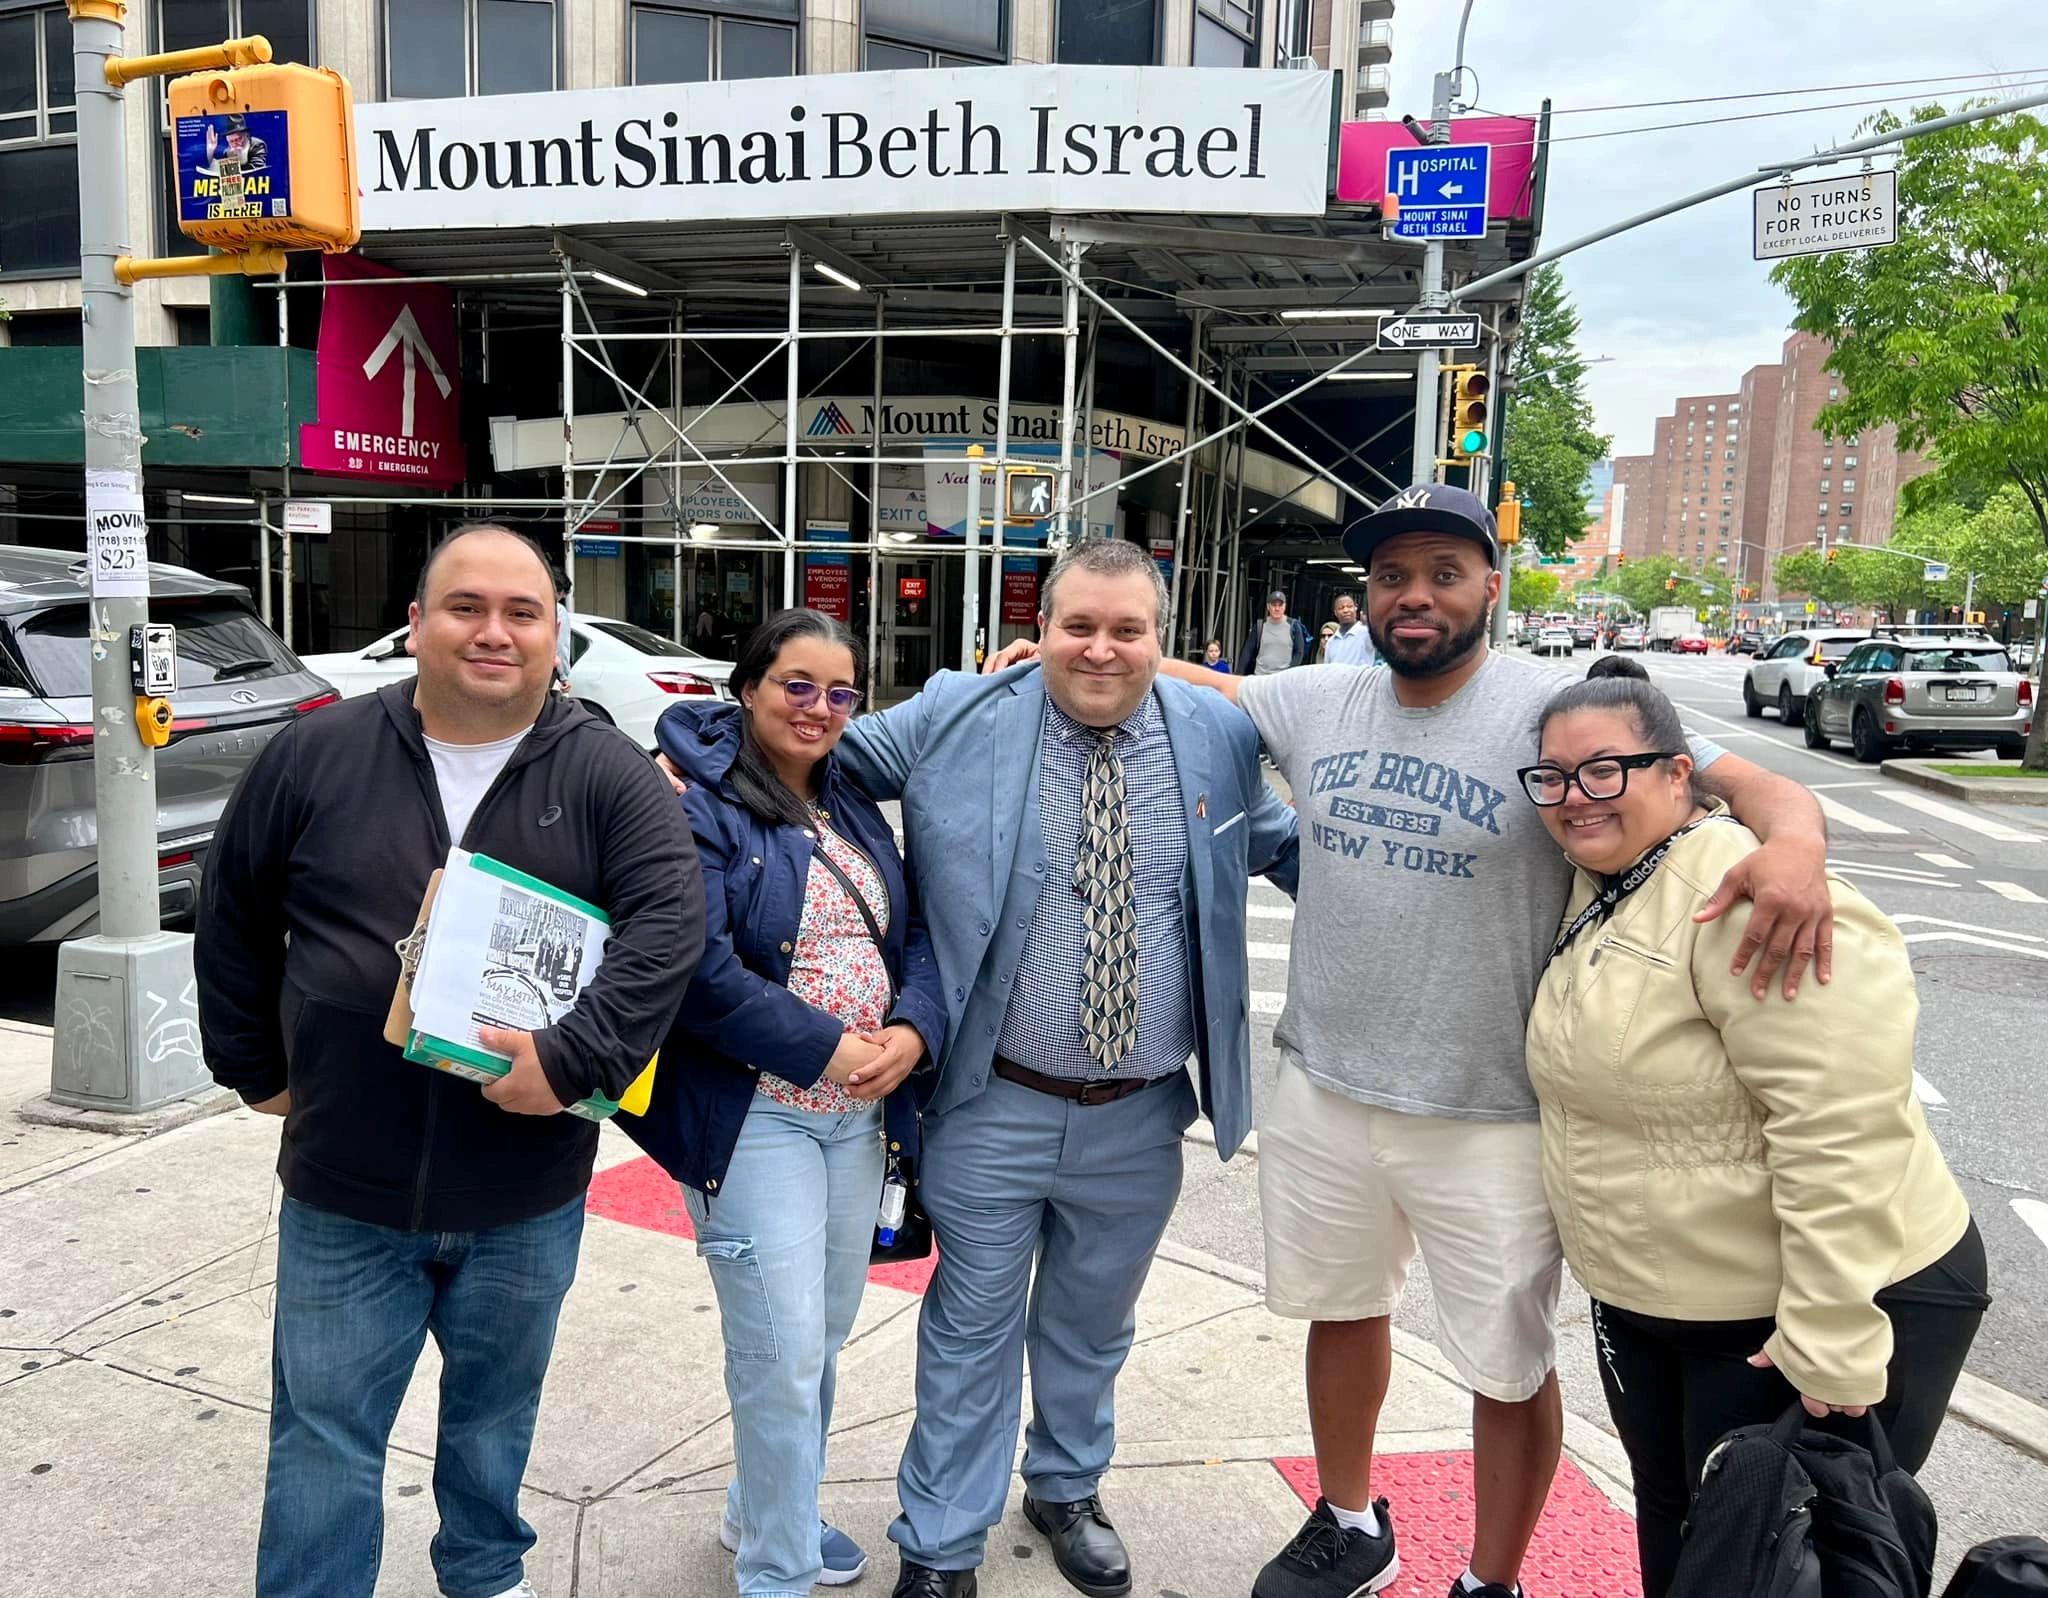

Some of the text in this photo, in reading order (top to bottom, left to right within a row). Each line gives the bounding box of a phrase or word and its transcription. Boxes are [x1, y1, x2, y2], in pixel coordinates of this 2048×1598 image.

[373, 100, 1267, 193] Mount Sinai Beth Israel
[193, 175, 271, 198] MEAH
[1397, 157, 1478, 196] HOSPITAL
[209, 203, 260, 217] IS HERE!
[1777, 187, 1872, 213] NO TURNS
[1403, 209, 1468, 222] MOUNT SINAI
[1766, 206, 1883, 235] FOR TRUCKS
[1402, 222, 1467, 234] BETH ISRAEL
[1763, 226, 1887, 250] EXCEPT LOCAL DELIVERIES
[1391, 325, 1471, 339] ONE WAY
[860, 404, 971, 435] Mount
[982, 405, 1060, 440] Snai
[1135, 424, 1184, 458] Isra
[334, 430, 440, 459] EMERGENCY
[378, 461, 429, 475] EMERGENCIA
[686, 496, 741, 507] PLOYEES
[96, 513, 144, 532] MOVIN
[662, 507, 759, 521] VNDORS ONLY
[879, 507, 913, 521] EXIT
[97, 536, 120, 547] (718)
[100, 548, 135, 570] $25
[807, 568, 848, 576] EMPLOYEES
[807, 596, 846, 604] EMERGENCY
[904, 588, 922, 596] ONLY
[1309, 749, 1506, 836] THE BRONX
[1335, 800, 1434, 833] EST. 1639
[1311, 820, 1478, 879] NEW YORK
[1621, 848, 1667, 891] adidas
[486, 979, 511, 995] MAY
[513, 990, 536, 1006] 14TH
[1594, 1300, 1625, 1394] aith
